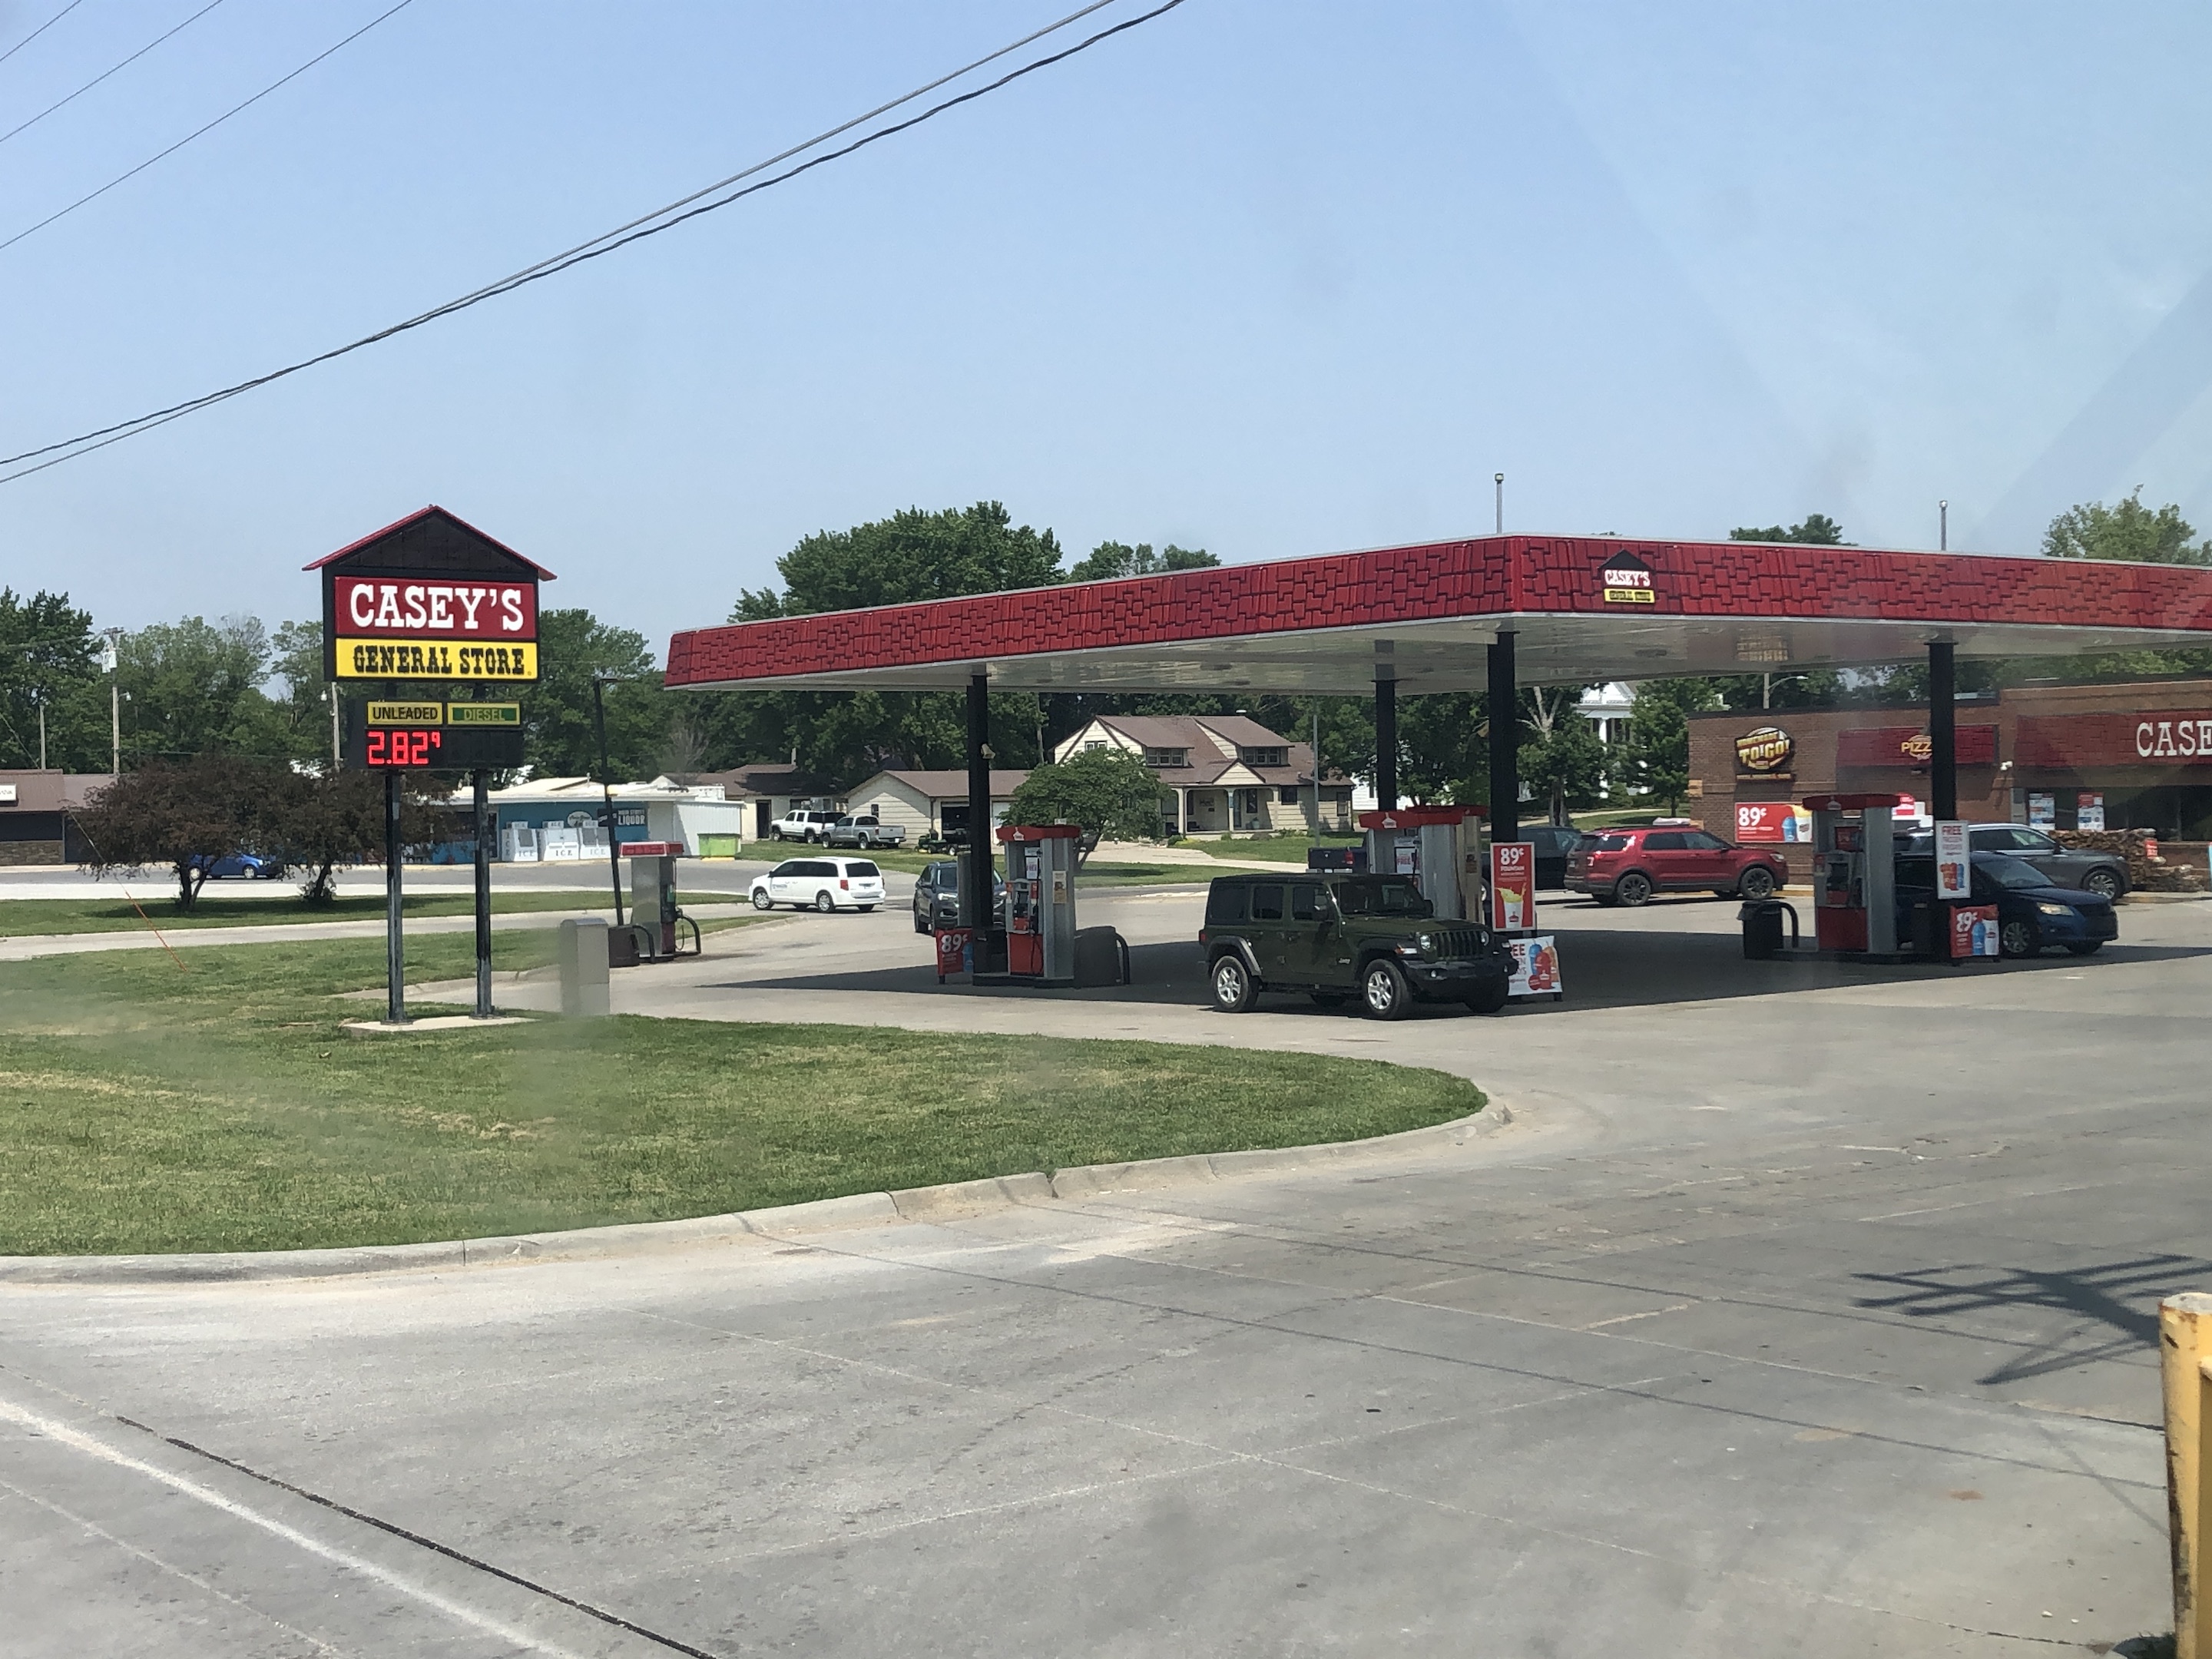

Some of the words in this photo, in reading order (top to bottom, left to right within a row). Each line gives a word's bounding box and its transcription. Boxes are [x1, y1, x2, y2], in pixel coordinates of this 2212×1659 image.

[1604, 570, 1651, 586] CASEY'S
[350, 584, 524, 631] CASEY'S
[353, 645, 452, 674] GENERAL
[459, 647, 525, 676] STORE
[373, 707, 438, 720] UNLEADED
[464, 709, 505, 721] DIESEL
[1901, 741, 1932, 753] PIZZ
[618, 815, 645, 826] LIQUOR
